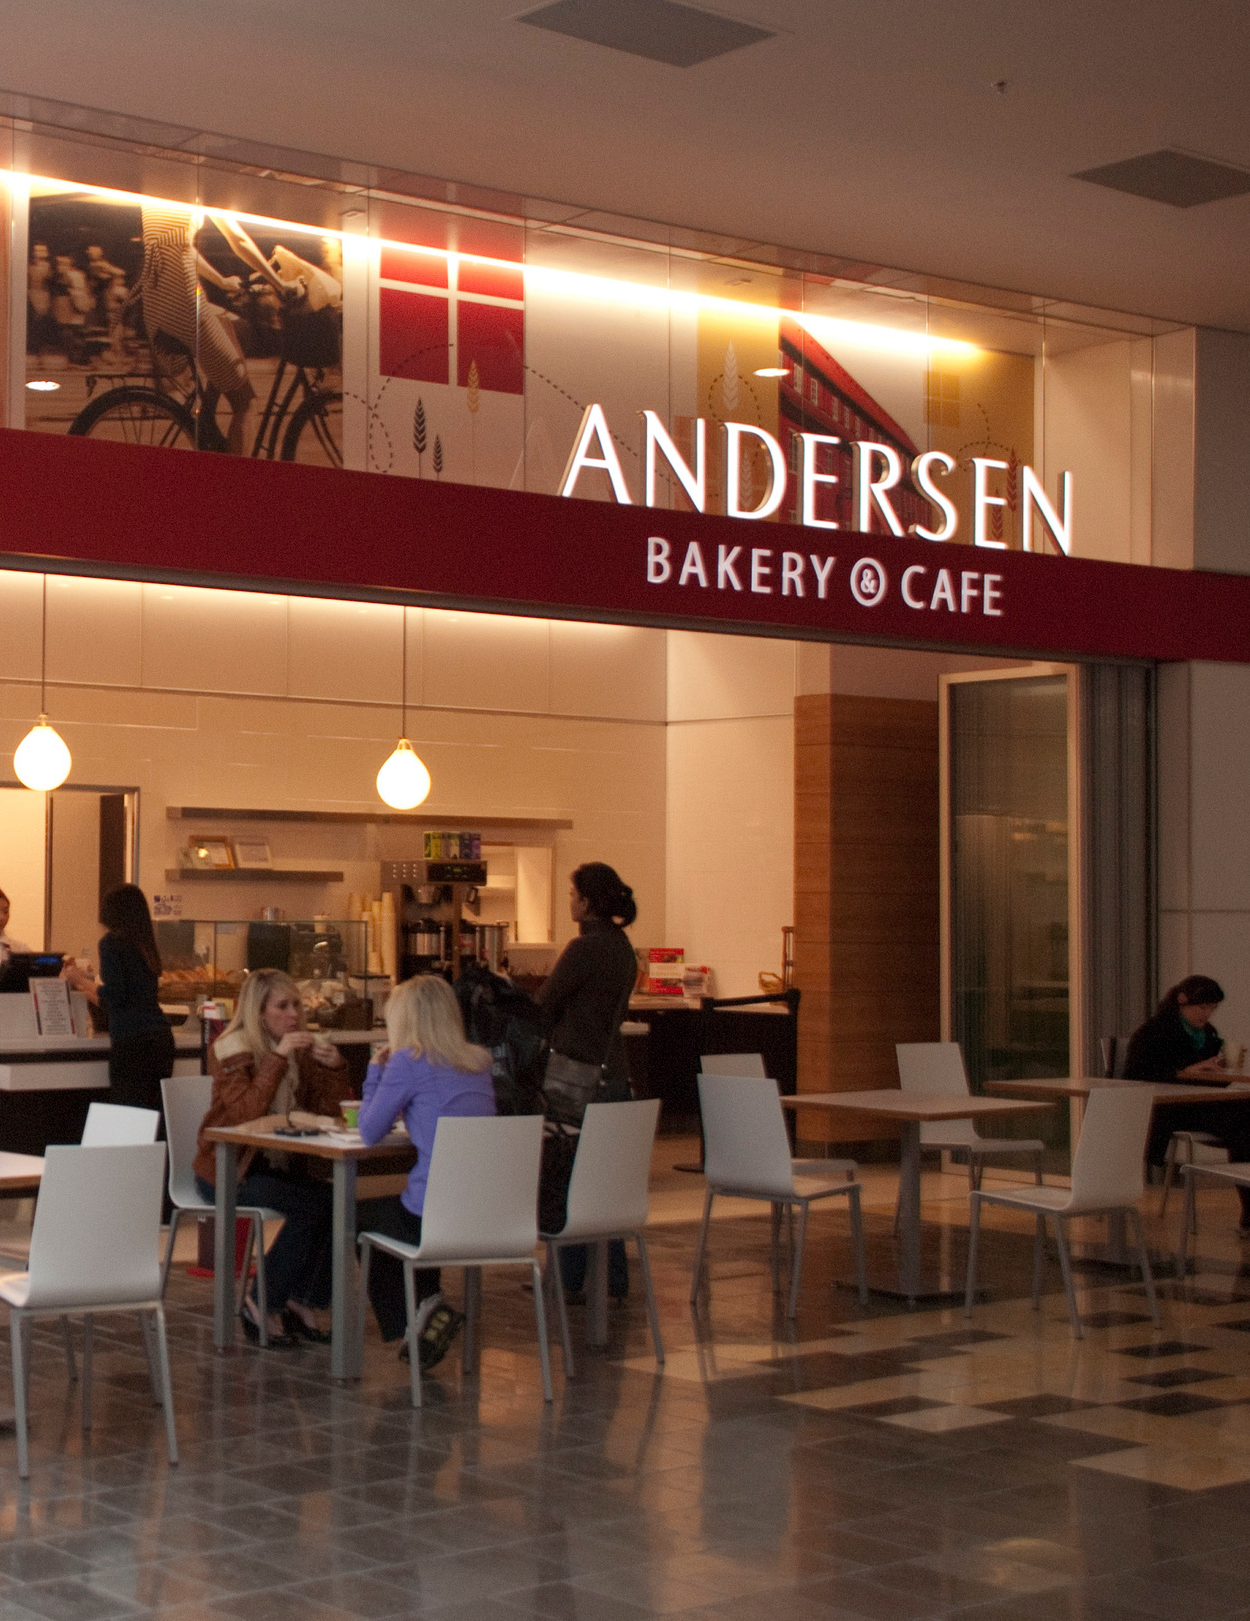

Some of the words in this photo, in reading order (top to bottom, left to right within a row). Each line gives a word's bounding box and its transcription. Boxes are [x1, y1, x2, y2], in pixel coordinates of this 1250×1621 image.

[557, 403, 1073, 557] ANDERSEN
[646, 536, 836, 599] BAKERY
[901, 565, 1004, 617] CAFE
